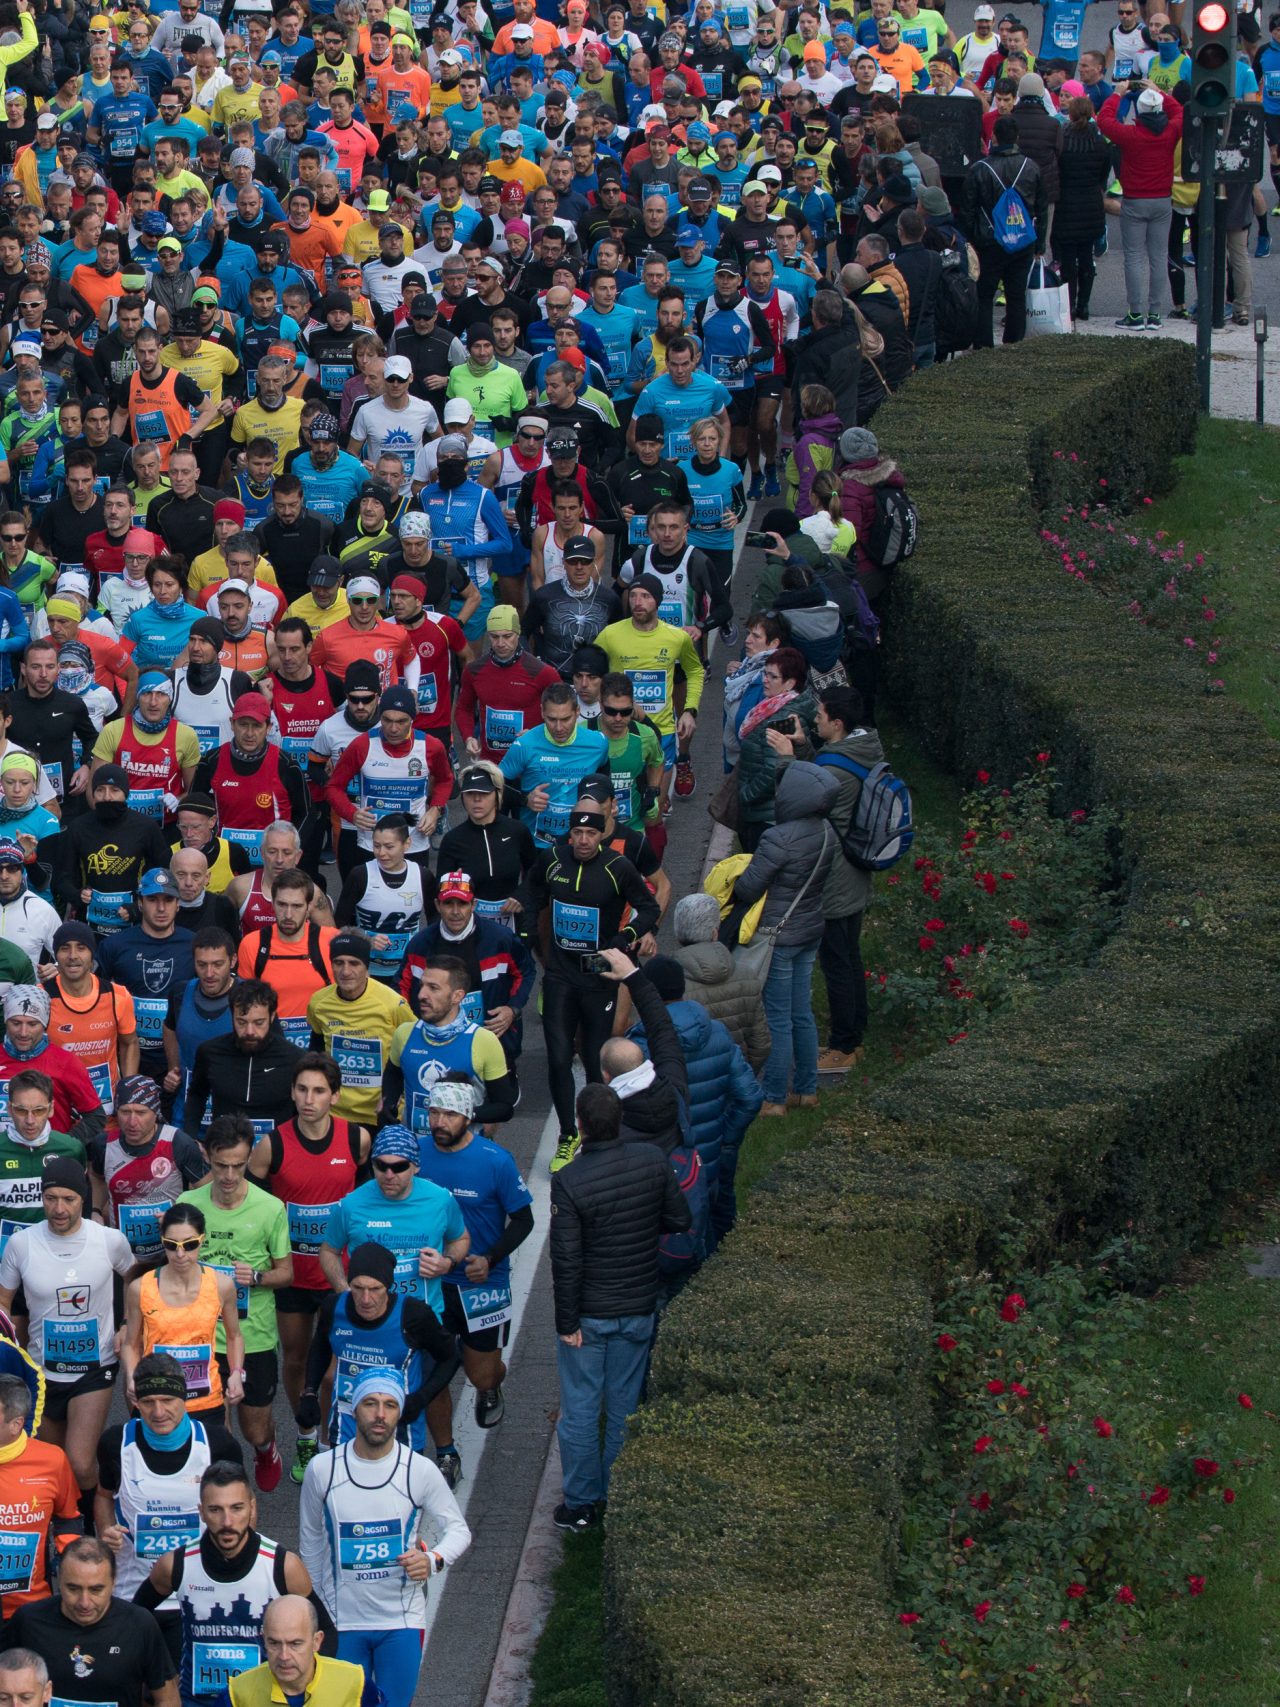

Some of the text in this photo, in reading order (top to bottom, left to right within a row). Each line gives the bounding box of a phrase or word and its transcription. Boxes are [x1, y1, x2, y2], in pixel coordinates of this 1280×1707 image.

[117, 138, 132, 146] 954
[288, 719, 320, 727] vicenza
[562, 906, 588, 915] Joma
[557, 919, 593, 932] H1972
[339, 1055, 374, 1067] 2633
[343, 1076, 369, 1084] Joma
[12, 1183, 42, 1193] ALPI
[481, 1314, 505, 1327] Joma
[53, 1324, 86, 1332] Joma
[49, 1337, 95, 1351] H1459
[342, 1351, 388, 1363] ALLEGRINI
[354, 1543, 388, 1559] 758
[356, 1571, 389, 1581] Joma
[206, 1649, 244, 1659] Joma
